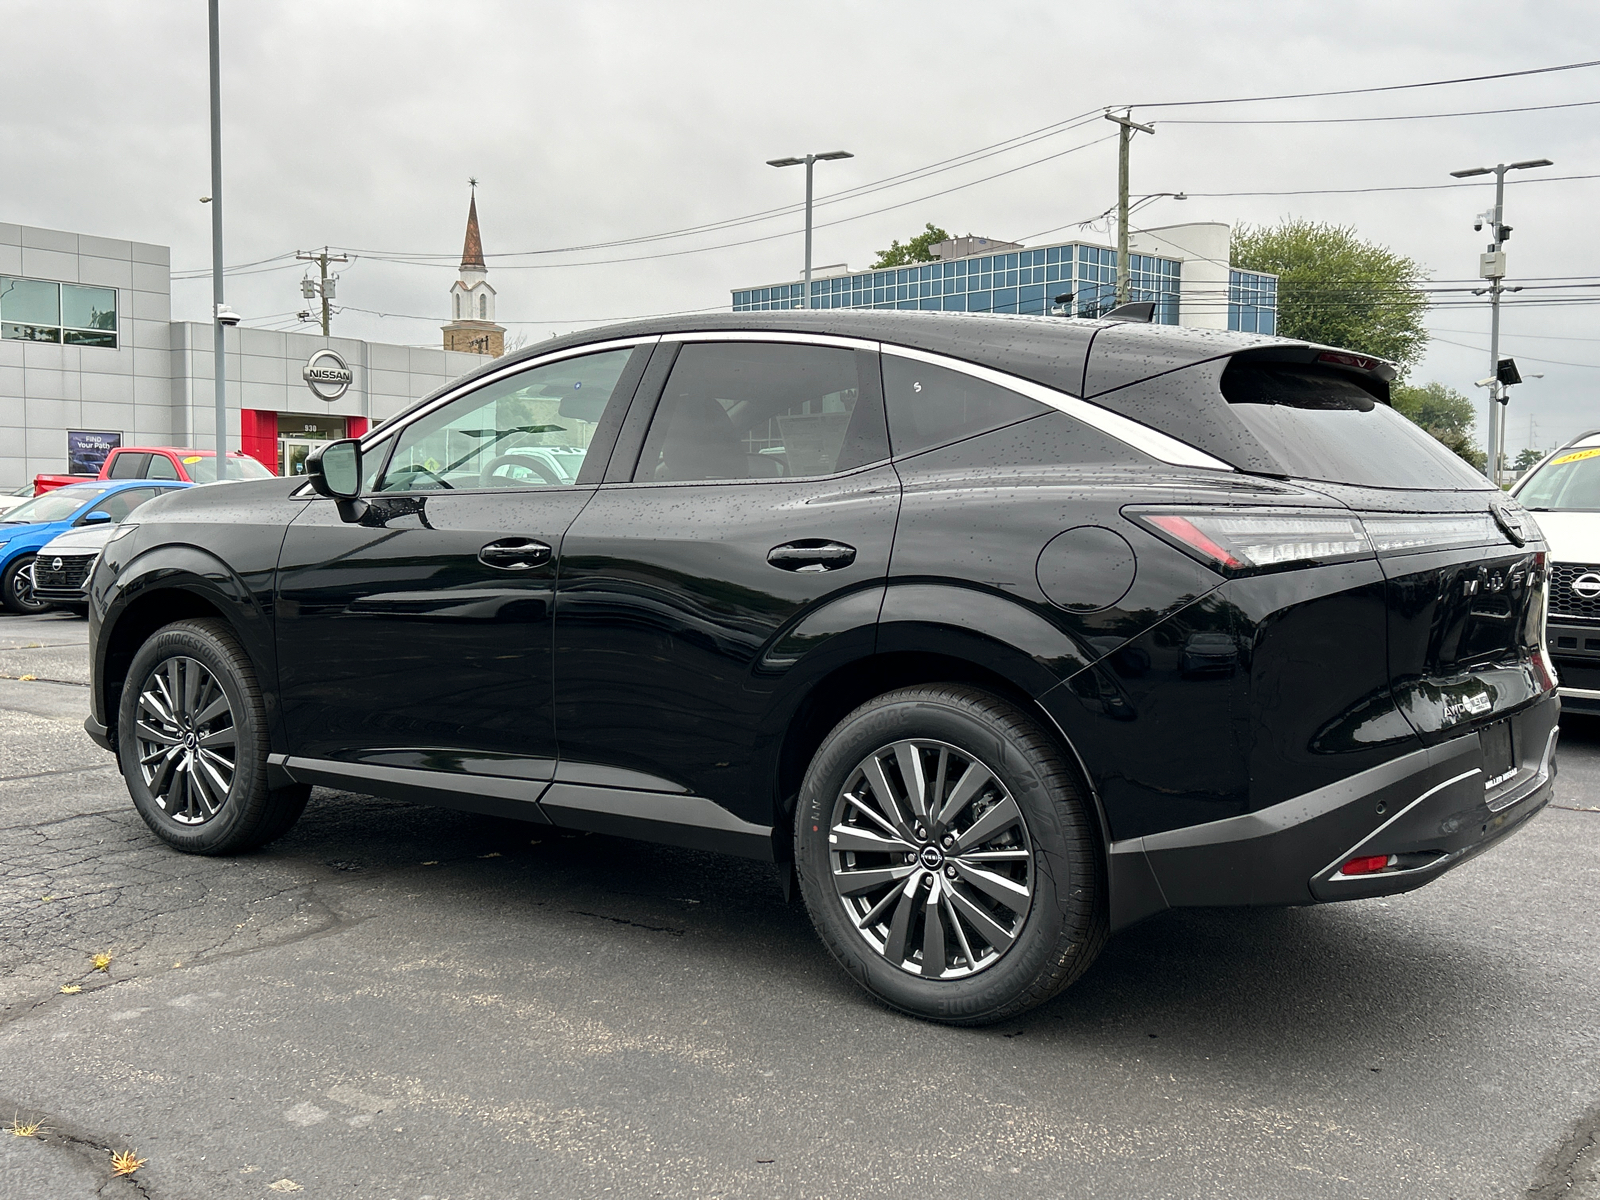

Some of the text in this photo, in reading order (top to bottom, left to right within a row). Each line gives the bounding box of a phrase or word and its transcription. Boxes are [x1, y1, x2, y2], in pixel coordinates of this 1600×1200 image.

[309, 369, 350, 380] NISSAN
[304, 424, 317, 432] 930
[157, 633, 223, 669] BRIDGESTONE
[1444, 703, 1466, 717] AWD
